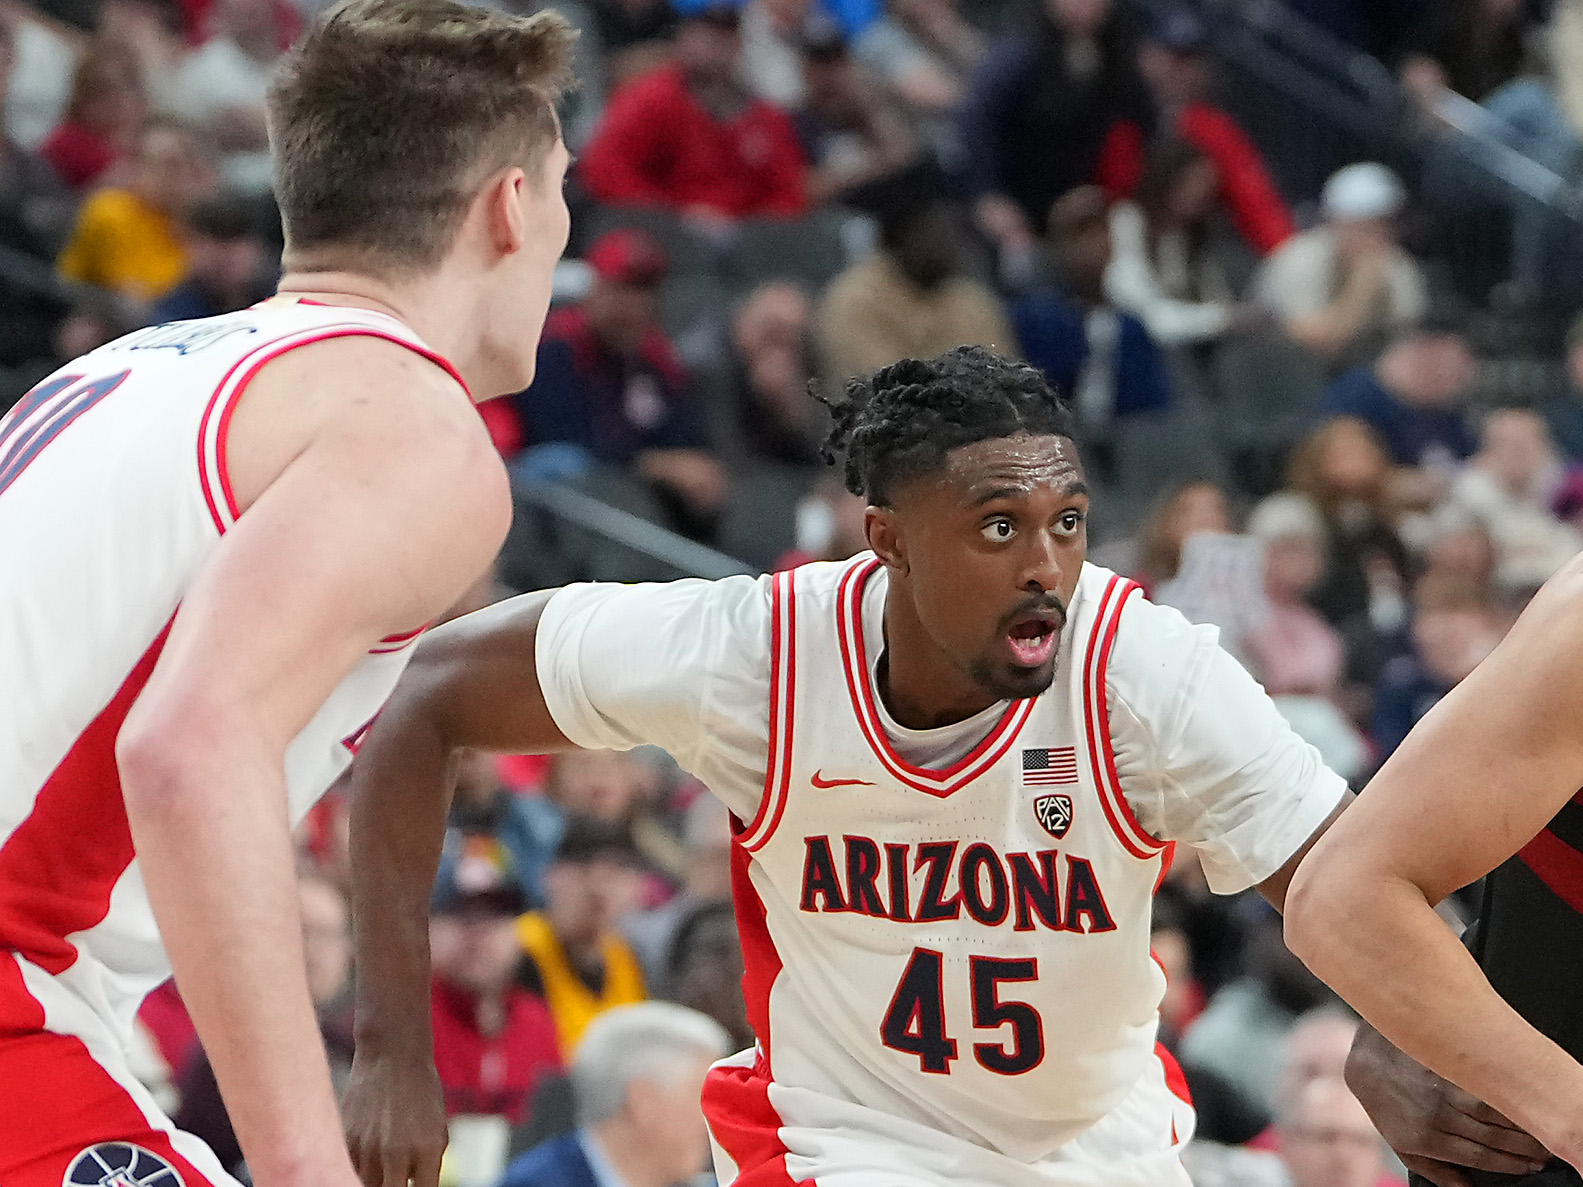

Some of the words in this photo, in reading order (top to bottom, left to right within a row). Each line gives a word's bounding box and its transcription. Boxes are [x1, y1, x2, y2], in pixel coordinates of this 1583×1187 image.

[1036, 796, 1070, 822] PAC
[1046, 814, 1066, 830] 12
[799, 834, 1117, 934] ARIZONA
[879, 946, 1045, 1076] 45
